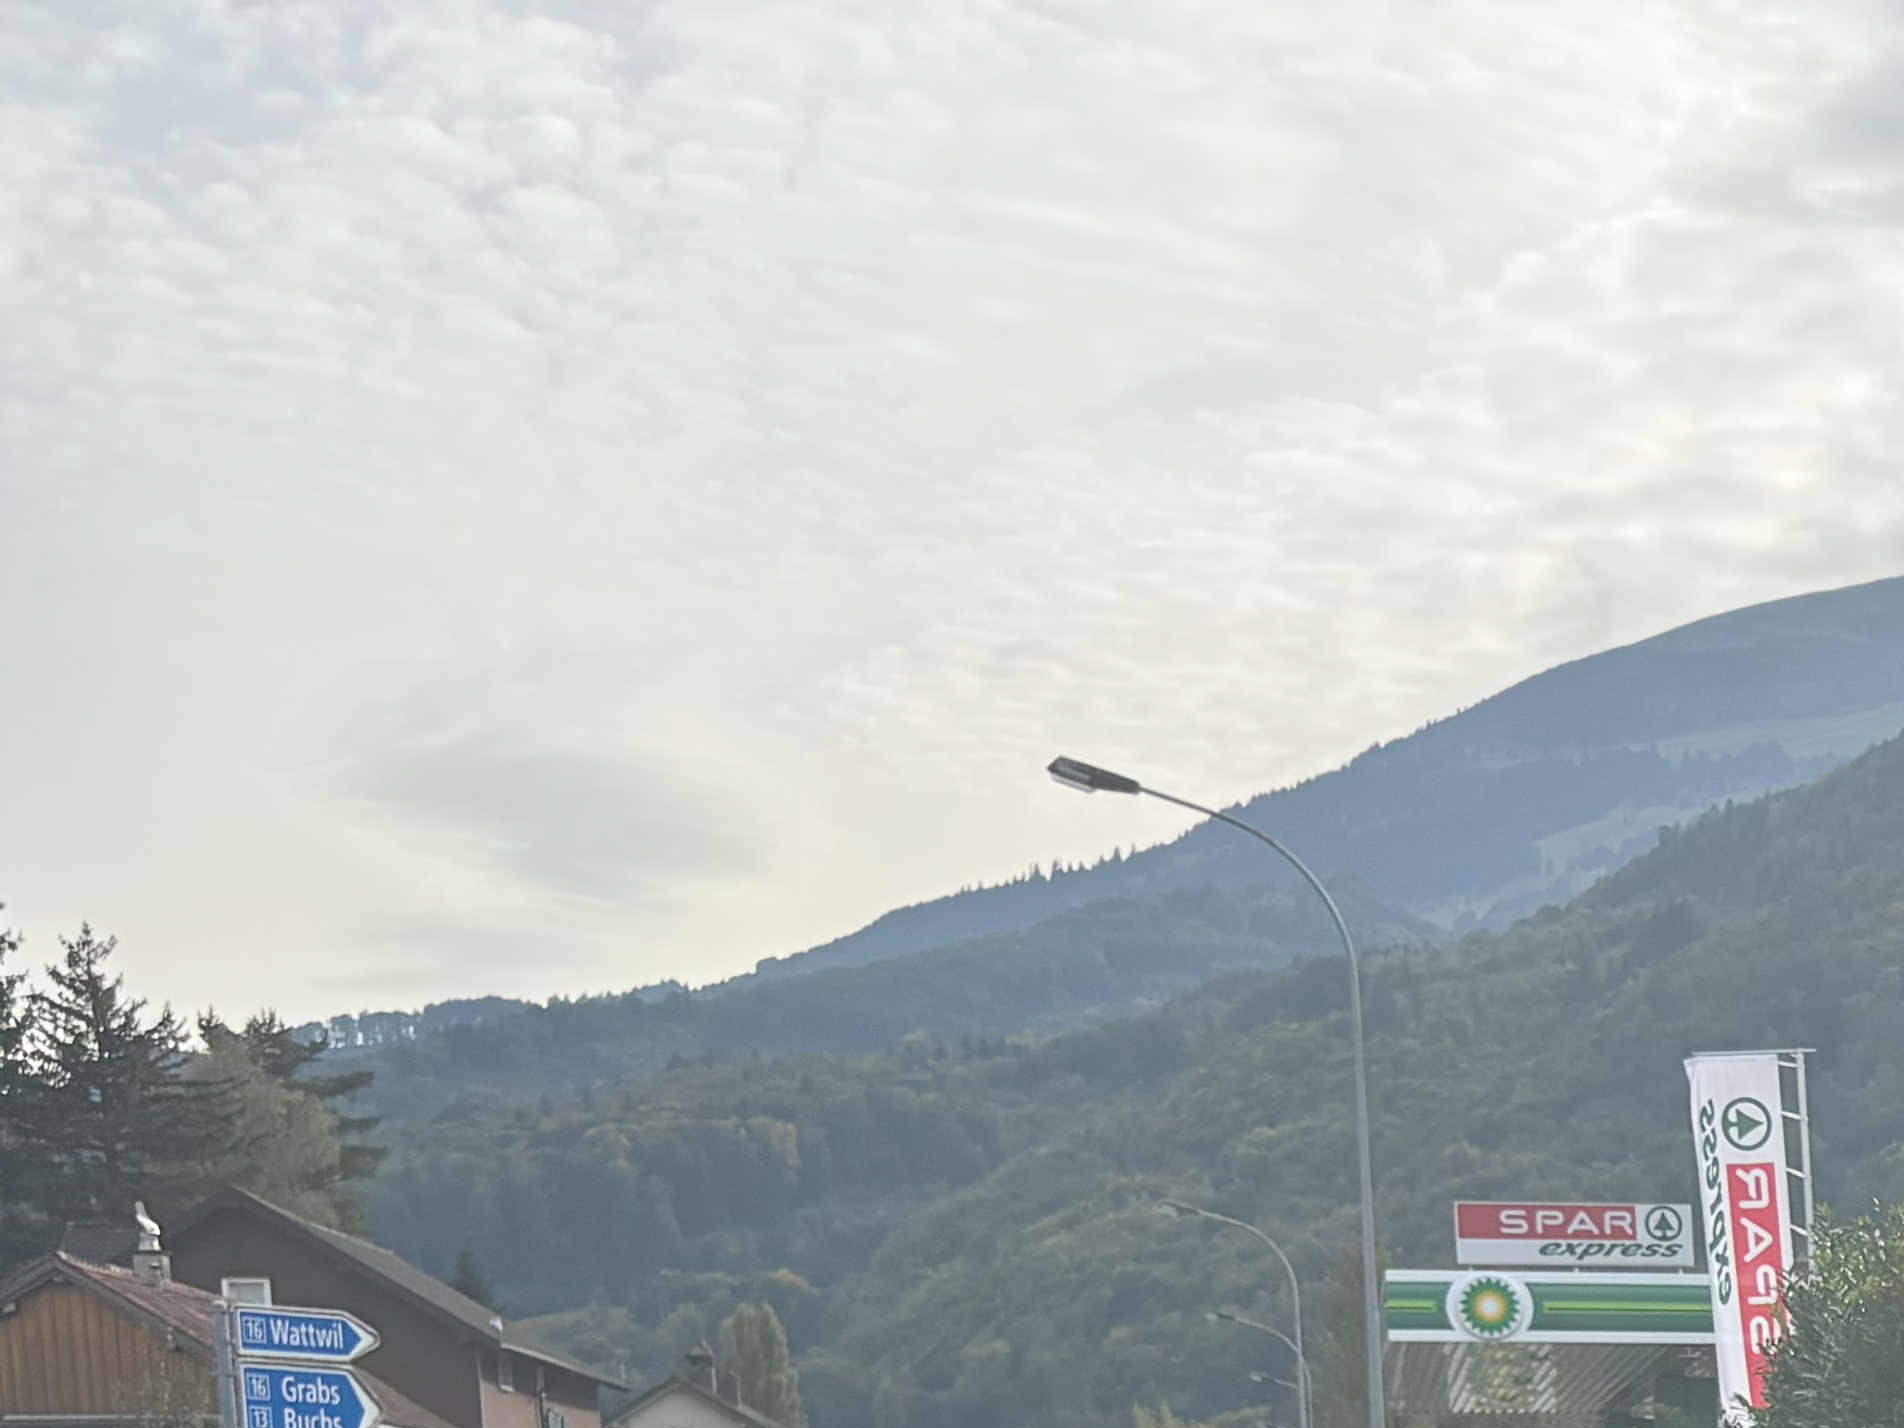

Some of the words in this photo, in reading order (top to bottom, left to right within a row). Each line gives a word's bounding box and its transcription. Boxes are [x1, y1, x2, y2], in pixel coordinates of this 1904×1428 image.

[1499, 1210, 1634, 1236] SPAR
[1538, 1242, 1684, 1261] express
[246, 1319, 263, 1341] 16
[269, 1319, 345, 1349] Wattwil
[251, 1377, 267, 1397] 16
[281, 1376, 341, 1405] Grabs
